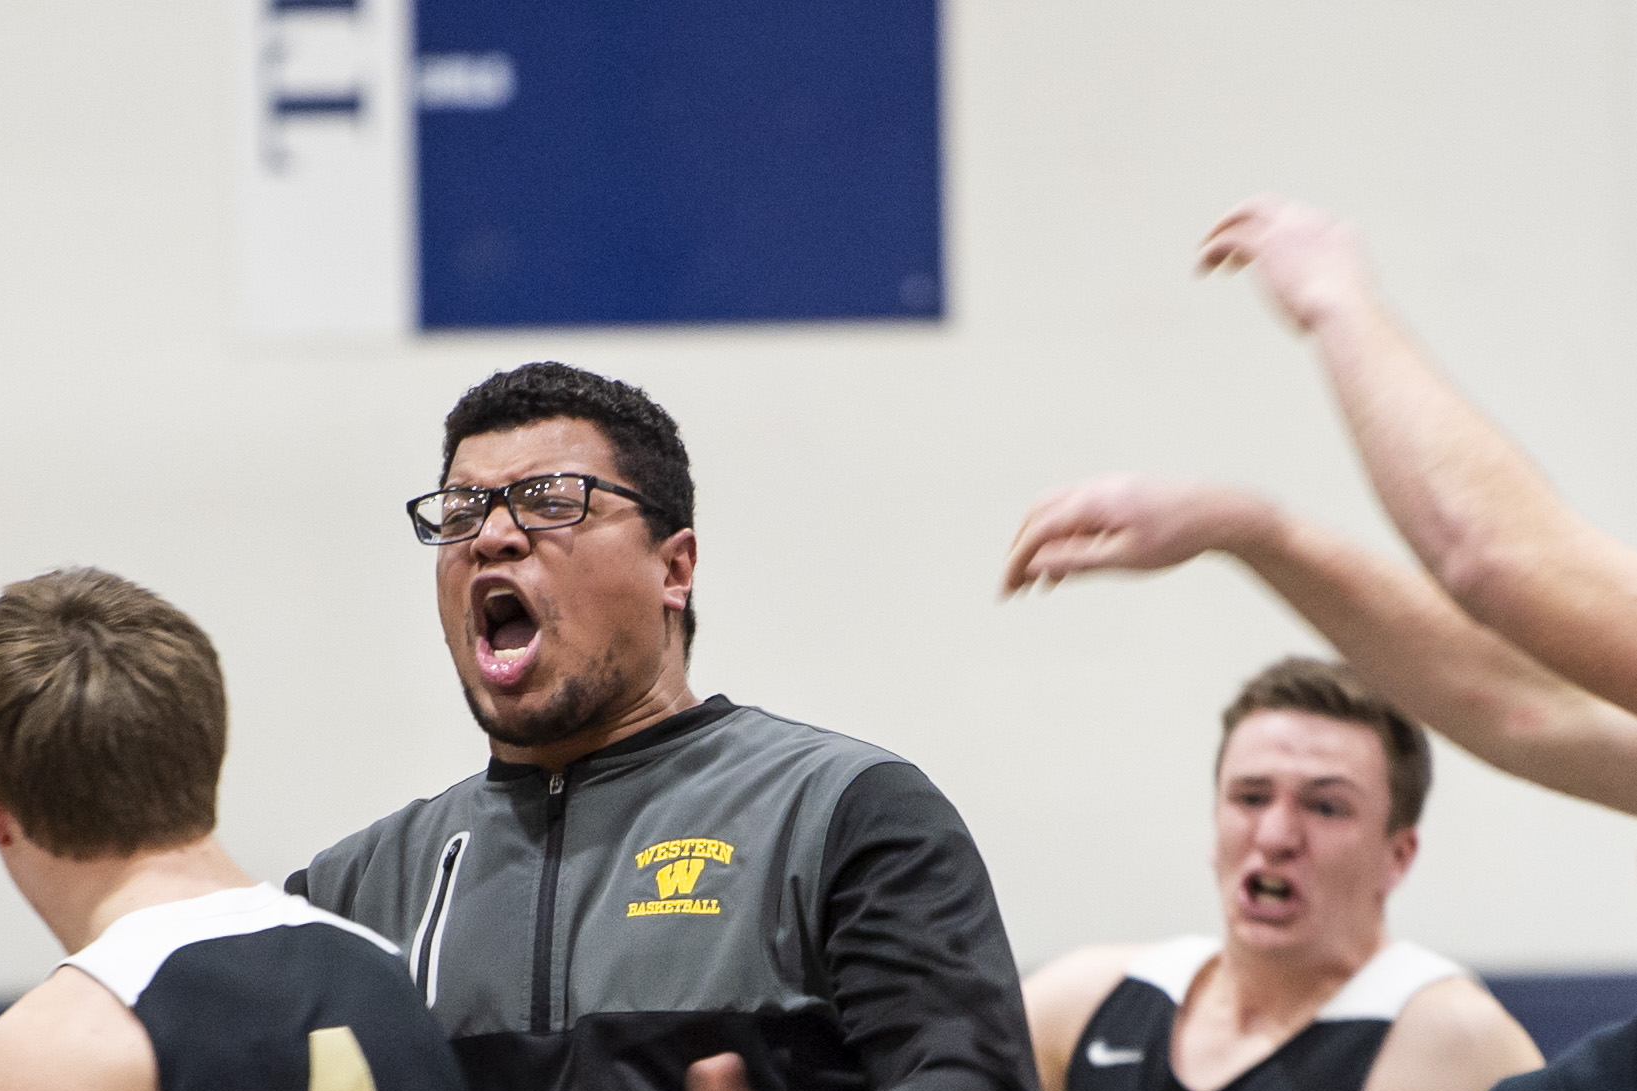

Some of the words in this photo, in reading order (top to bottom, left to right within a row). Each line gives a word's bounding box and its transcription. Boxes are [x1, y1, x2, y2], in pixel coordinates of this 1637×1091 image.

[635, 838, 734, 869] WESTERN
[656, 858, 705, 899] W
[627, 900, 720, 917] BASKETBALL
